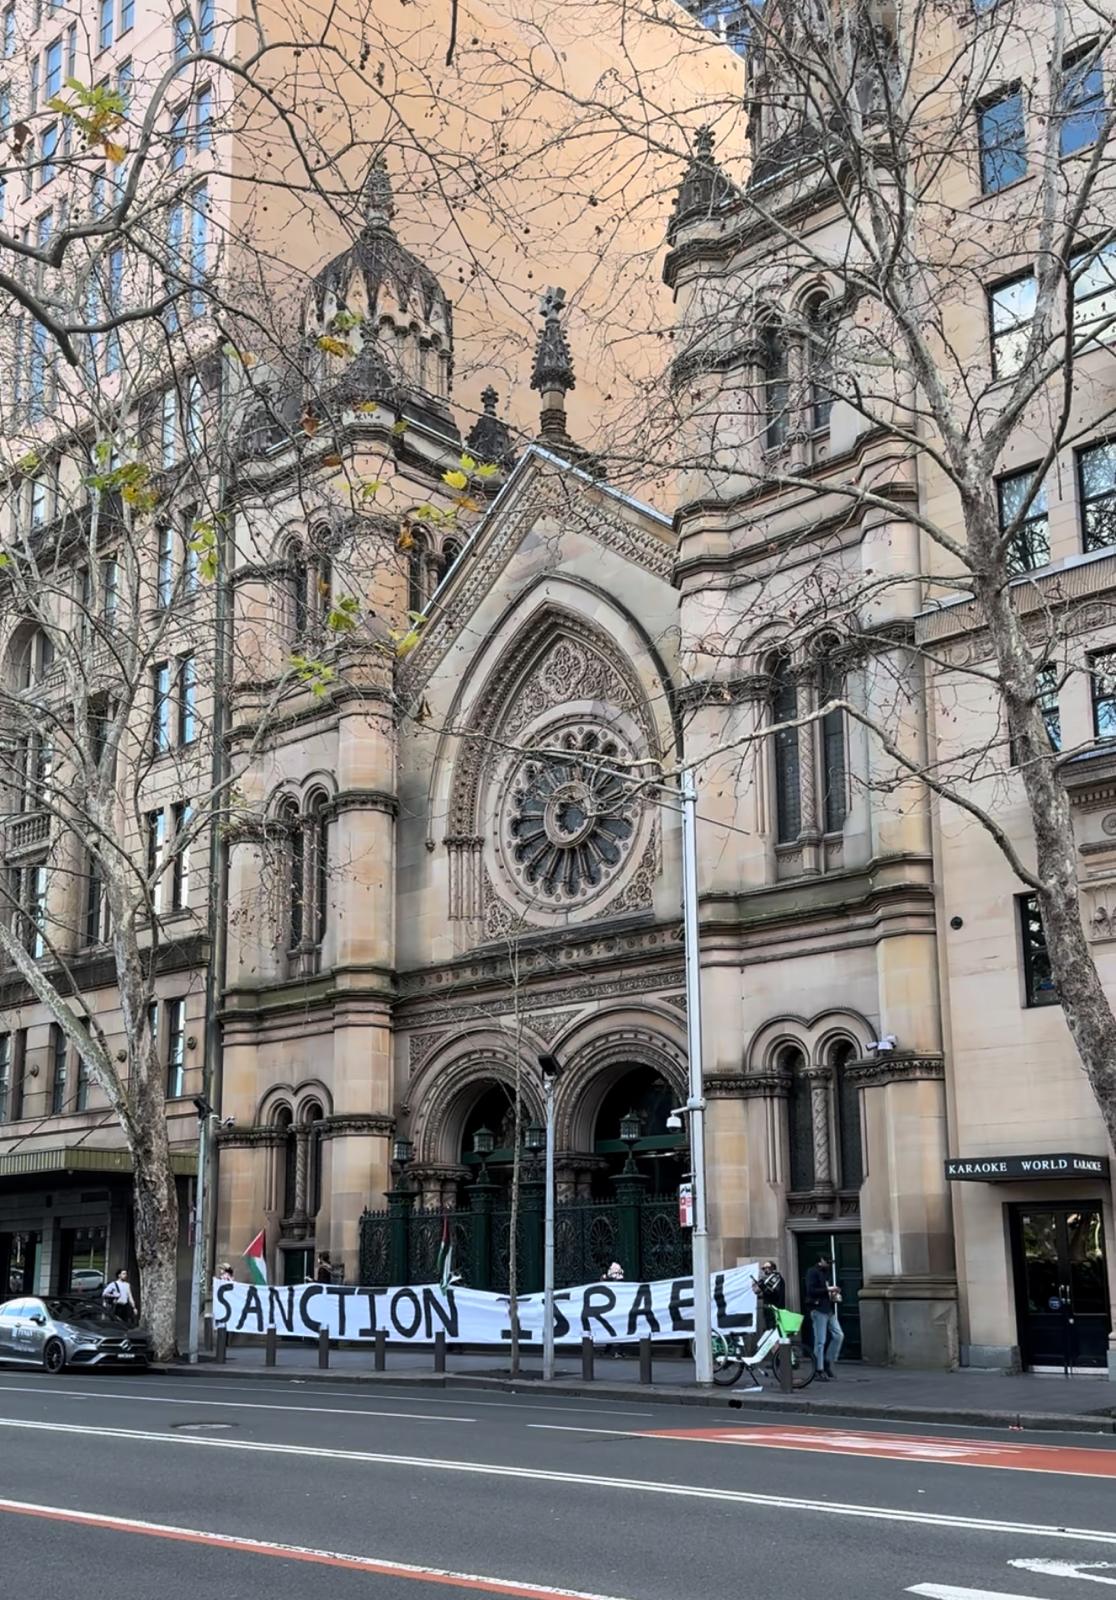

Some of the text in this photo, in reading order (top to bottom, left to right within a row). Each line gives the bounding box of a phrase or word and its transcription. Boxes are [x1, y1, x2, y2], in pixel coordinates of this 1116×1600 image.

[948, 1159, 1067, 1174] KARAOKE WORLD
[215, 1274, 754, 1340] SANCTION ISRAEL
